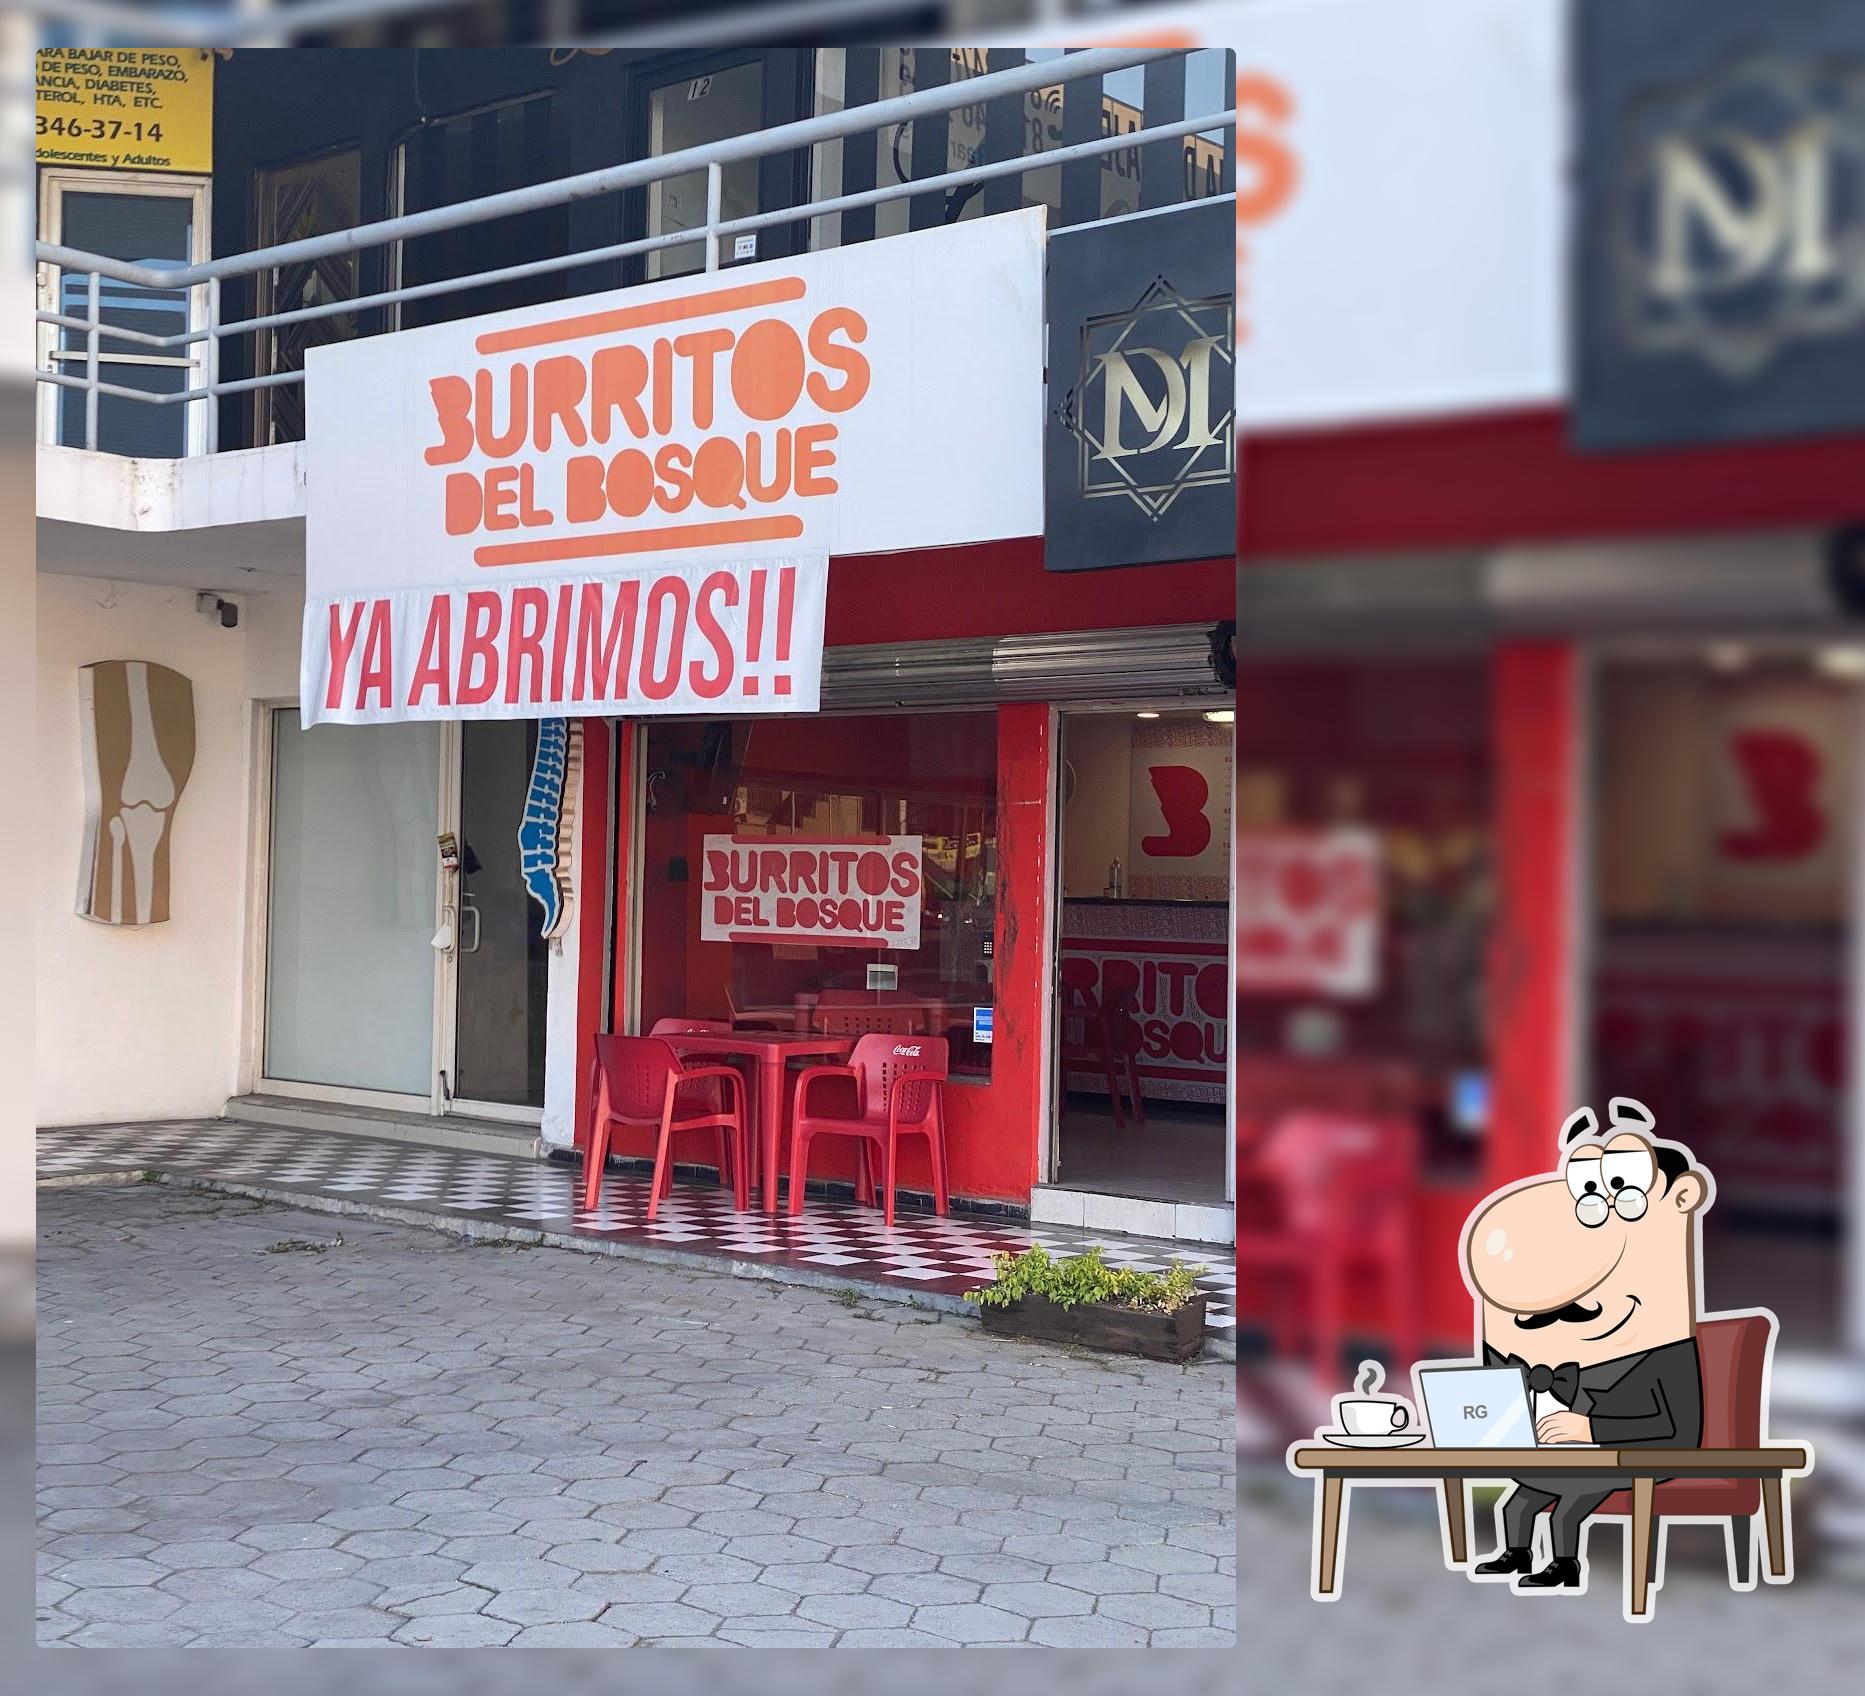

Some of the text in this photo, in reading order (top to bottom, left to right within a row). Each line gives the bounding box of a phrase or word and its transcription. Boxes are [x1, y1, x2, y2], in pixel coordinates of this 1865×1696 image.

[68, 49, 113, 62] BAJAR
[117, 51, 137, 64] DE
[141, 54, 181, 68] PESO,
[41, 61, 189, 83] DE PESO, EMBARAZO,
[85, 79, 156, 95] DIABETES,
[691, 78, 710, 98] 12
[93, 94, 126, 107] HTA,
[133, 96, 163, 109] ETC.
[36, 115, 163, 142] 346-37-14
[111, 155, 119, 167] y
[122, 153, 171, 167] Adultos
[424, 306, 871, 466] BURRITOS
[445, 422, 839, 536] DEL BOSQUE
[325, 566, 797, 710] YA ABRIMOS!!
[703, 849, 920, 898] BURRITOS
[713, 895, 905, 933] DEL BOSQUE
